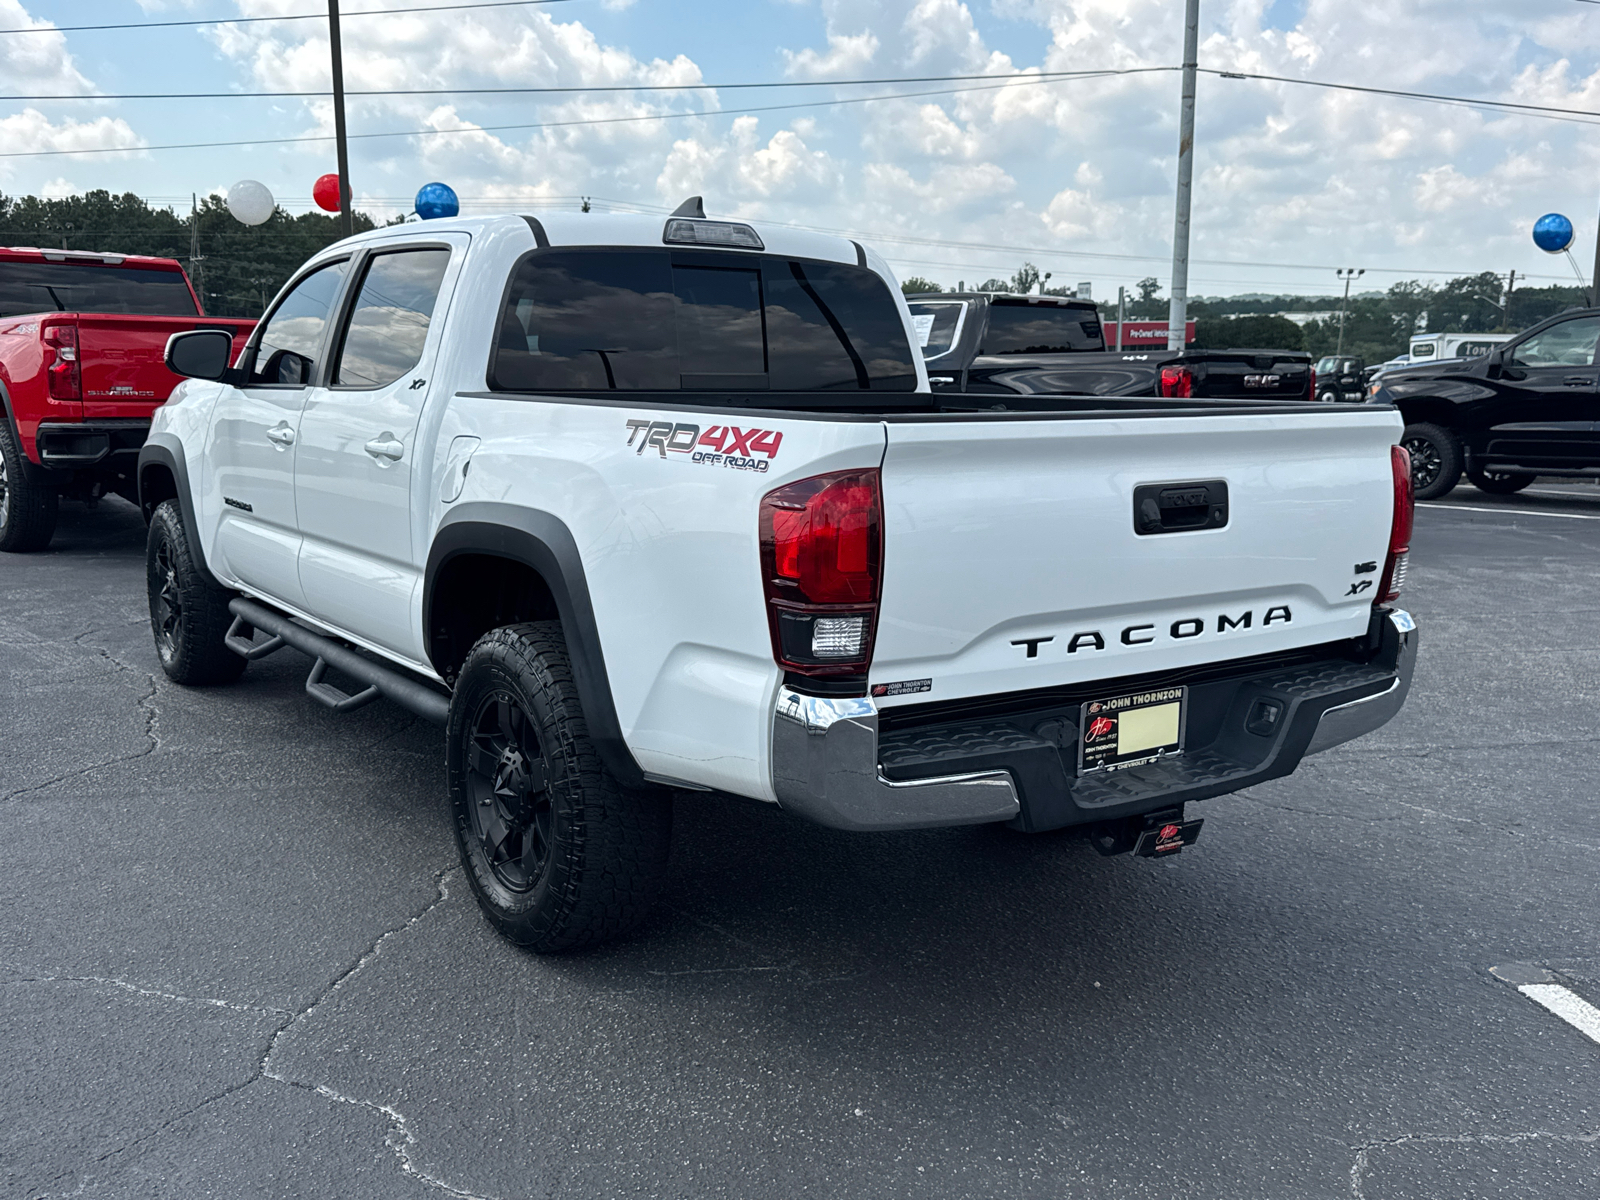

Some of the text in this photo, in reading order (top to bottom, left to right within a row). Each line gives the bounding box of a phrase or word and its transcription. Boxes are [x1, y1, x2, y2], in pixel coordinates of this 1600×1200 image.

[1244, 375, 1280, 388] GMC
[626, 419, 700, 459] TRD
[692, 451, 770, 473] OFF ROAD
[1165, 490, 1209, 506] TOYOTA
[1354, 560, 1377, 574] V6
[1010, 605, 1293, 659] TACOMA
[887, 682, 902, 690] JOHN
[887, 687, 920, 696] CHEVROLET
[1106, 698, 1131, 710] JOHN
[1085, 746, 1096, 754] JOHN
[1095, 743, 1118, 752] THORNTON
[1117, 759, 1148, 770] CHEVROLET
